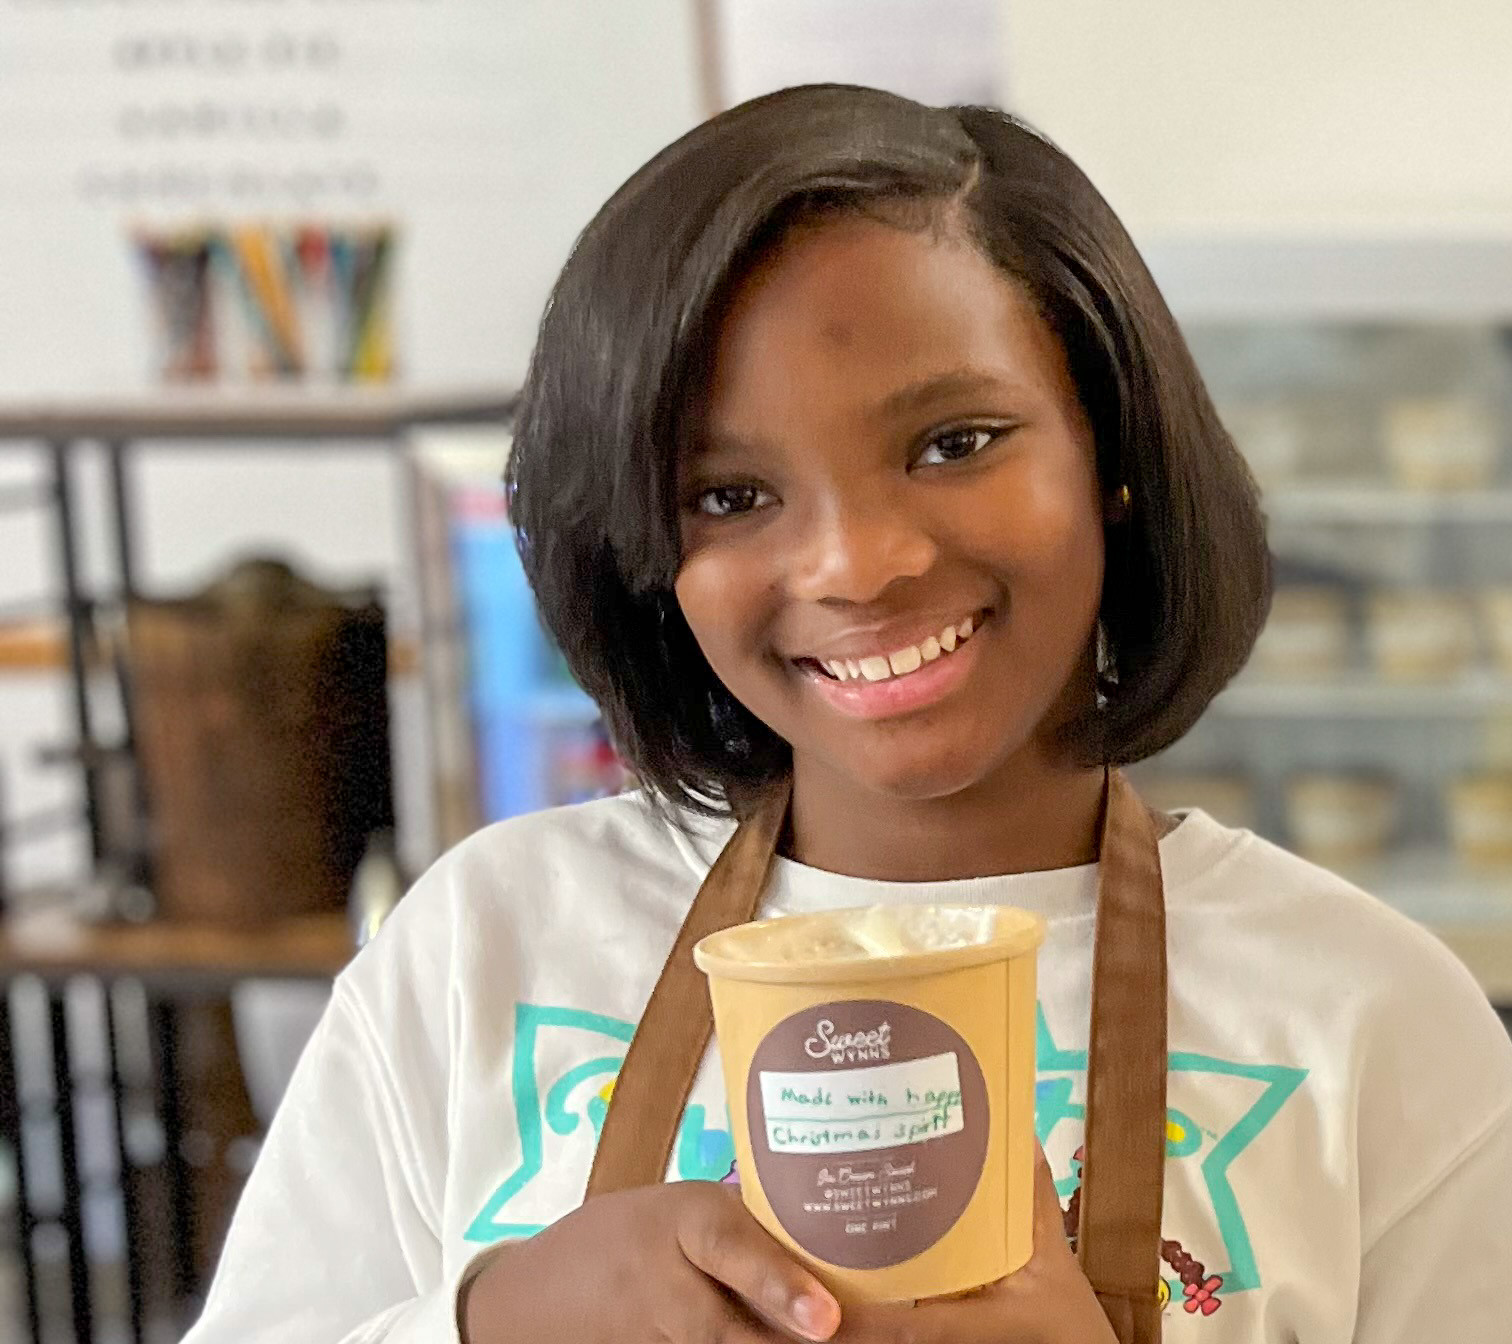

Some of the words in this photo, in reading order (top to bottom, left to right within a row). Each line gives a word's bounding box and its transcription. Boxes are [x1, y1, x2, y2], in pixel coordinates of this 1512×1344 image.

[804, 1018, 891, 1059] Sweet
[780, 1086, 833, 1106] Made
[847, 1089, 888, 1106] with
[772, 1125, 881, 1147] Christmas
